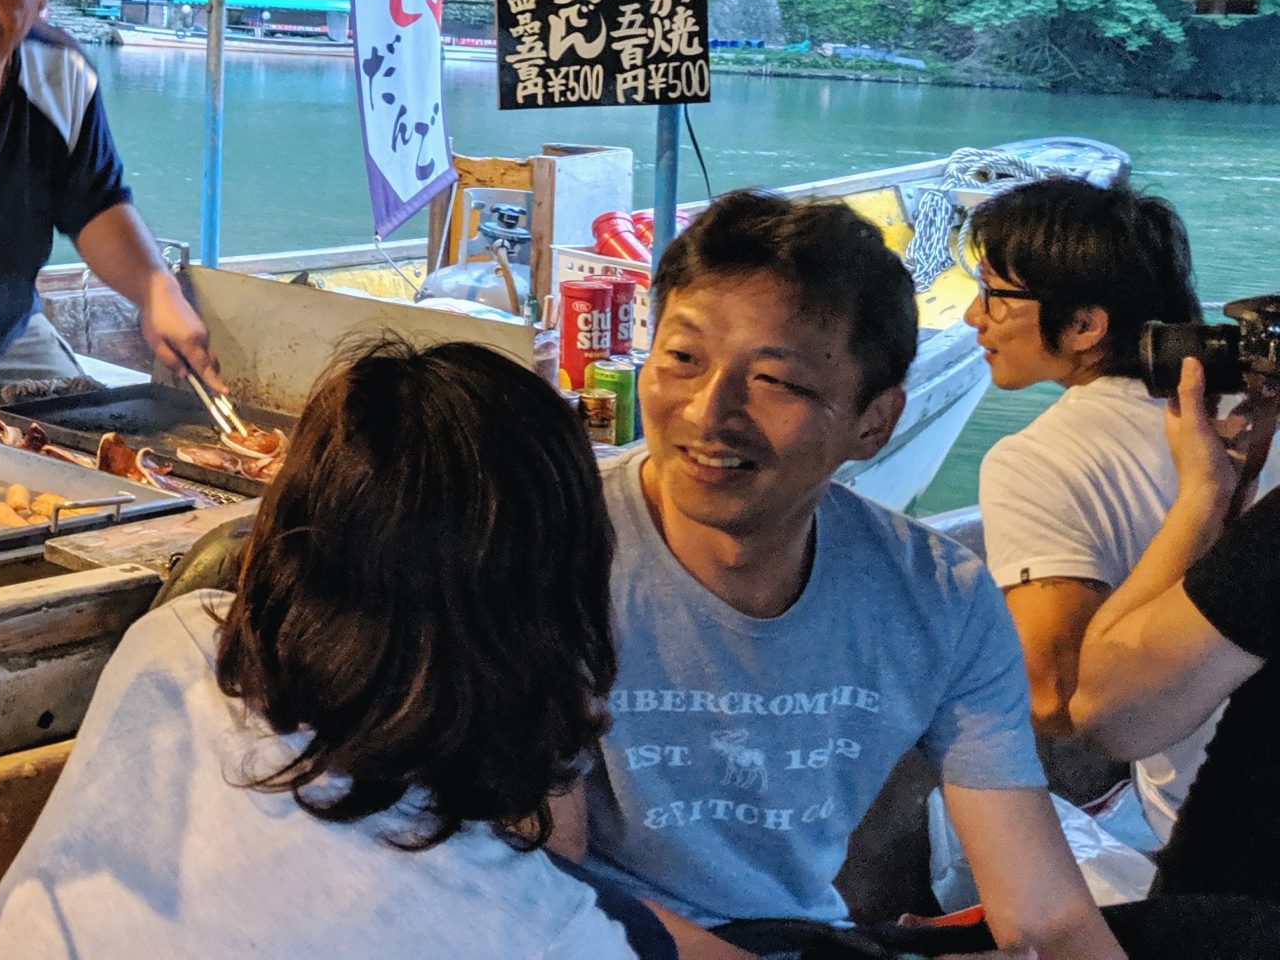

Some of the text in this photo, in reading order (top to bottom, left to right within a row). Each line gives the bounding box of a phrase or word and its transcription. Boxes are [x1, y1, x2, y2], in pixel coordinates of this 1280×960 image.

[610, 3, 649, 104] 五百円
[648, 60, 709, 100] ¥500
[362, 34, 440, 182] だんご
